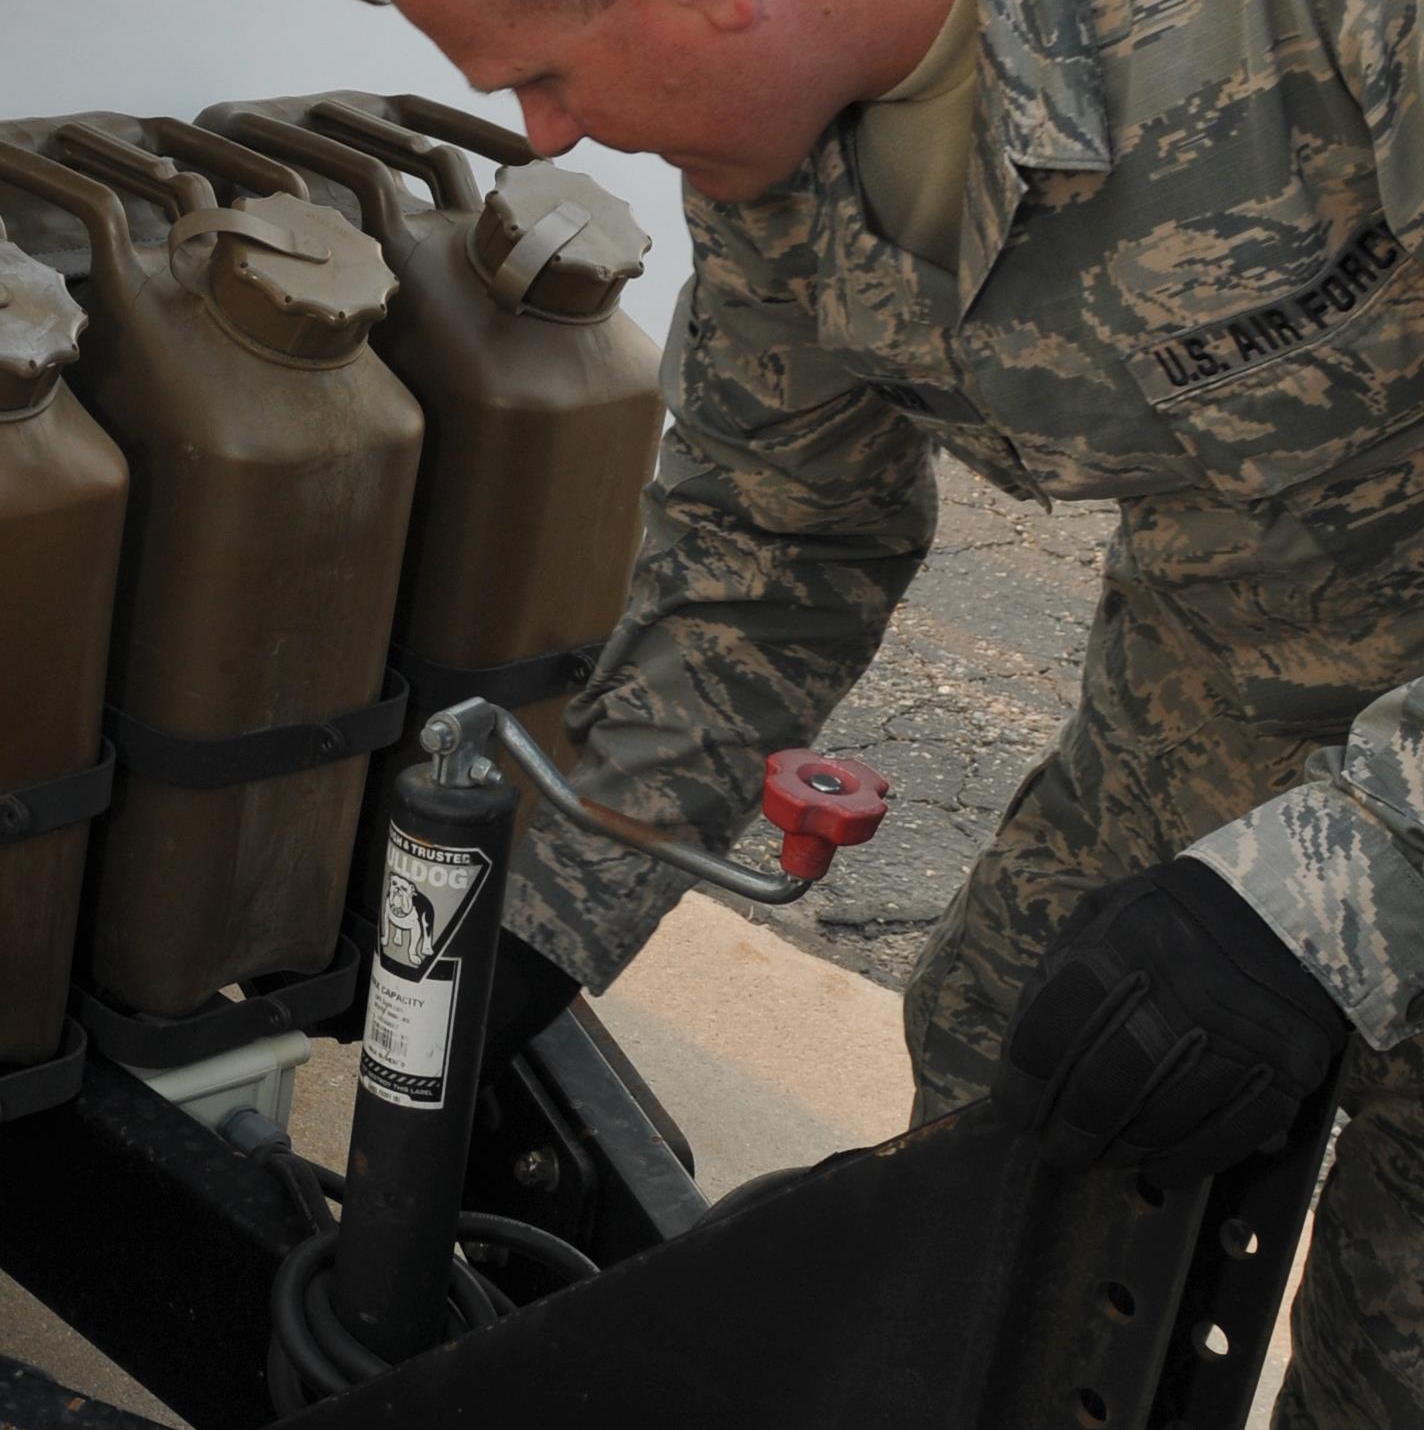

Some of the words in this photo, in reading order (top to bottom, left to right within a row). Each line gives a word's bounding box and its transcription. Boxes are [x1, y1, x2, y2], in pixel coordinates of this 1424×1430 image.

[1152, 335, 1232, 389] U.S.
[1227, 305, 1305, 363] AIR
[1295, 217, 1402, 331] FORC
[386, 843, 469, 890] ULLDOG
[380, 985, 426, 1010] CAPACITY
